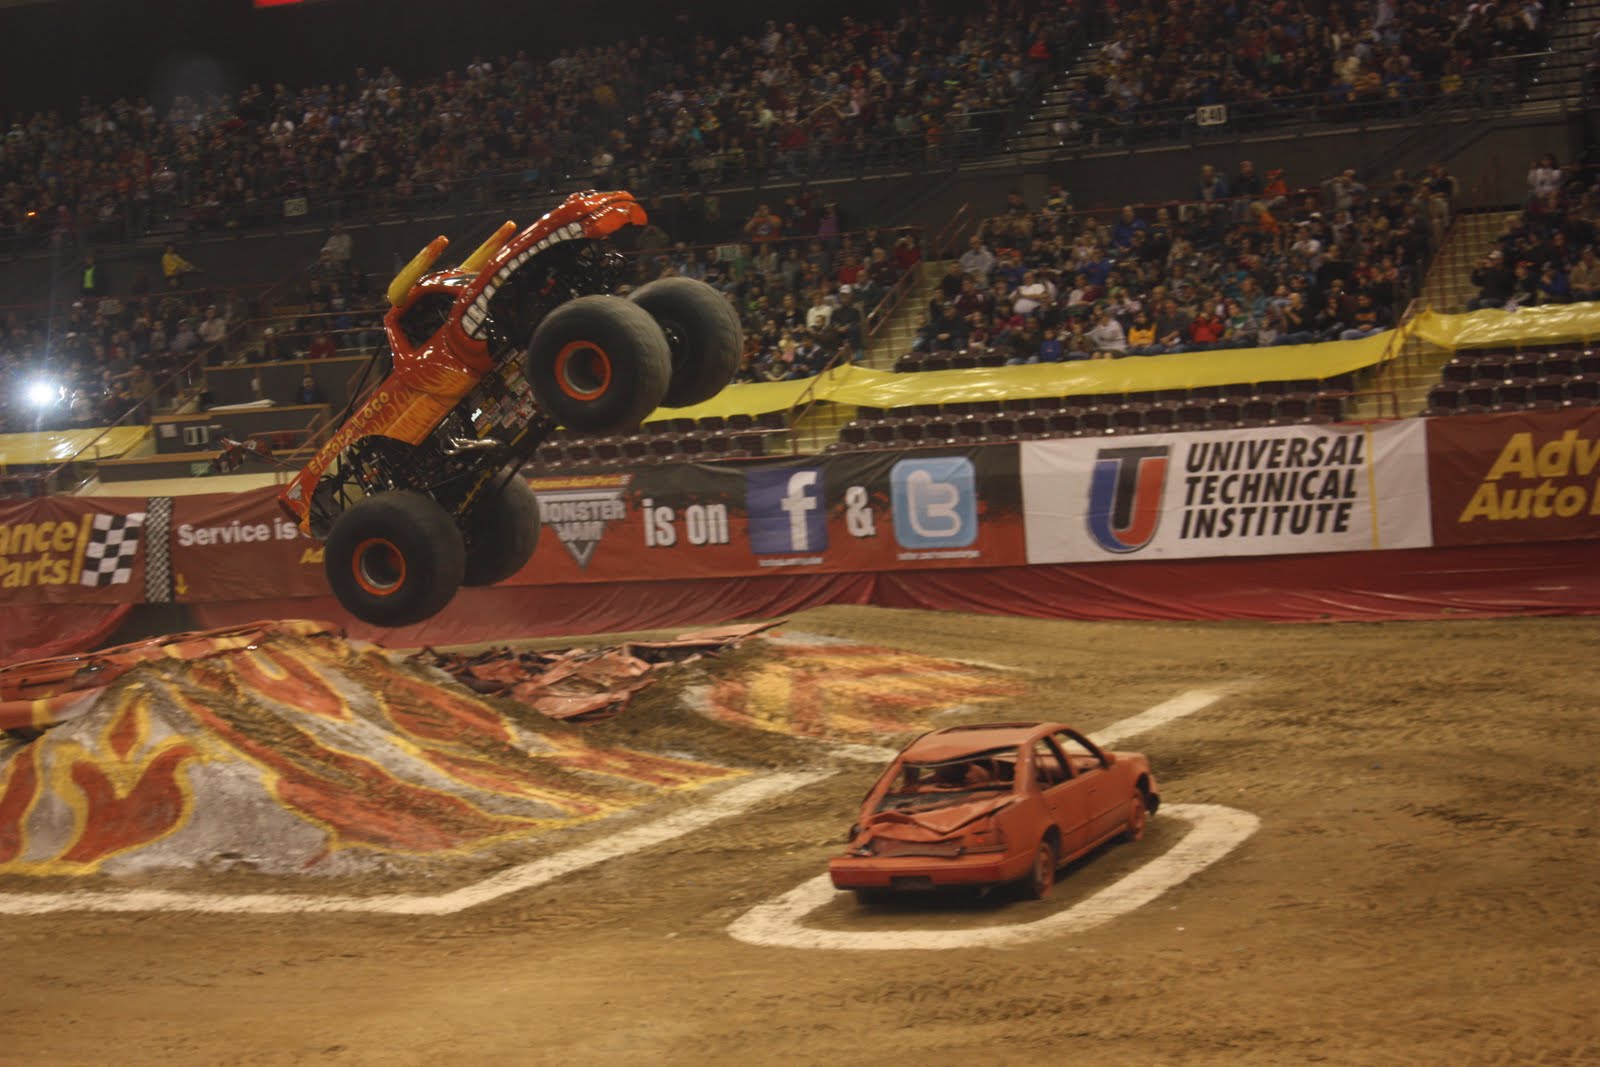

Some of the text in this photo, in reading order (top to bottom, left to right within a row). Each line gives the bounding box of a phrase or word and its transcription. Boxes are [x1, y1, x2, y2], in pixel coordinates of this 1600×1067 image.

[1186, 434, 1364, 473] UNIVERSAL
[1184, 468, 1358, 506] TECHNICAL
[1458, 478, 1587, 523] Auto
[177, 517, 299, 547] Service is
[642, 498, 677, 547] is
[686, 503, 729, 546] on
[846, 485, 876, 537] &
[1179, 502, 1353, 539] INSTITUTE
